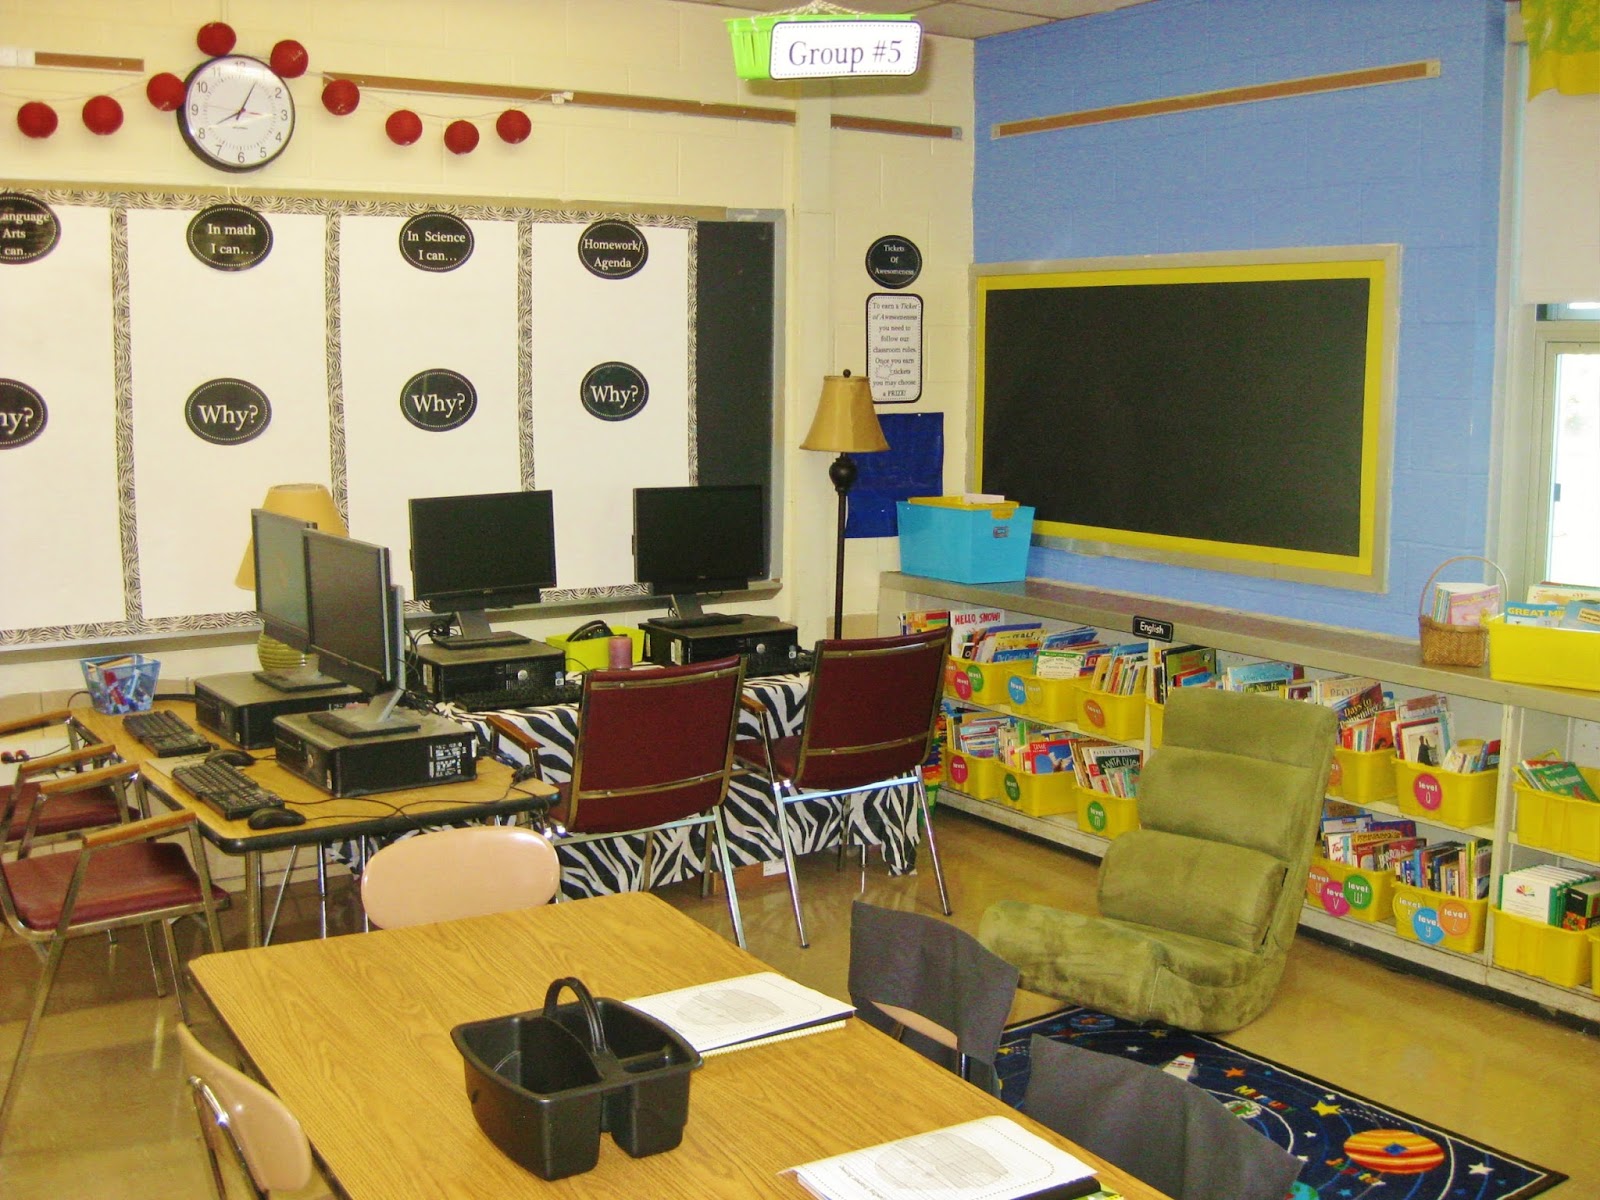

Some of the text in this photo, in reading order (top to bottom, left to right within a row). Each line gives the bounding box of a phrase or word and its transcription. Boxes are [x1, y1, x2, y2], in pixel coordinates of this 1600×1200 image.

[788, 40, 902, 73] Group #5
[197, 81, 208, 94] 10
[275, 87, 282, 98] 2
[191, 104, 199, 116] 9
[281, 109, 288, 121] 3
[198, 127, 206, 139] 8
[275, 132, 282, 142] 4
[216, 145, 222, 156] 7
[260, 147, 267, 158] 5
[238, 152, 245, 163] 6
[3, 228, 26, 239] Arts
[207, 224, 256, 237] In math
[407, 230, 466, 243] In Science
[211, 244, 217, 254] I
[584, 238, 642, 253] Homework/
[883, 244, 905, 252] Tickets
[419, 250, 424, 260] I
[890, 256, 899, 264] Of
[594, 257, 632, 270] Agenda
[590, 385, 639, 409] Why?
[412, 392, 466, 418] Why?
[198, 404, 259, 431] Why?
[979, 612, 1001, 624] SNOW!
[1507, 607, 1545, 617] GREAT
[1140, 621, 1164, 635] English
[1418, 781, 1438, 792] level
[1309, 871, 1329, 883] level
[1348, 881, 1368, 893] level
[1326, 888, 1344, 899] leve
[1444, 908, 1467, 919] level
